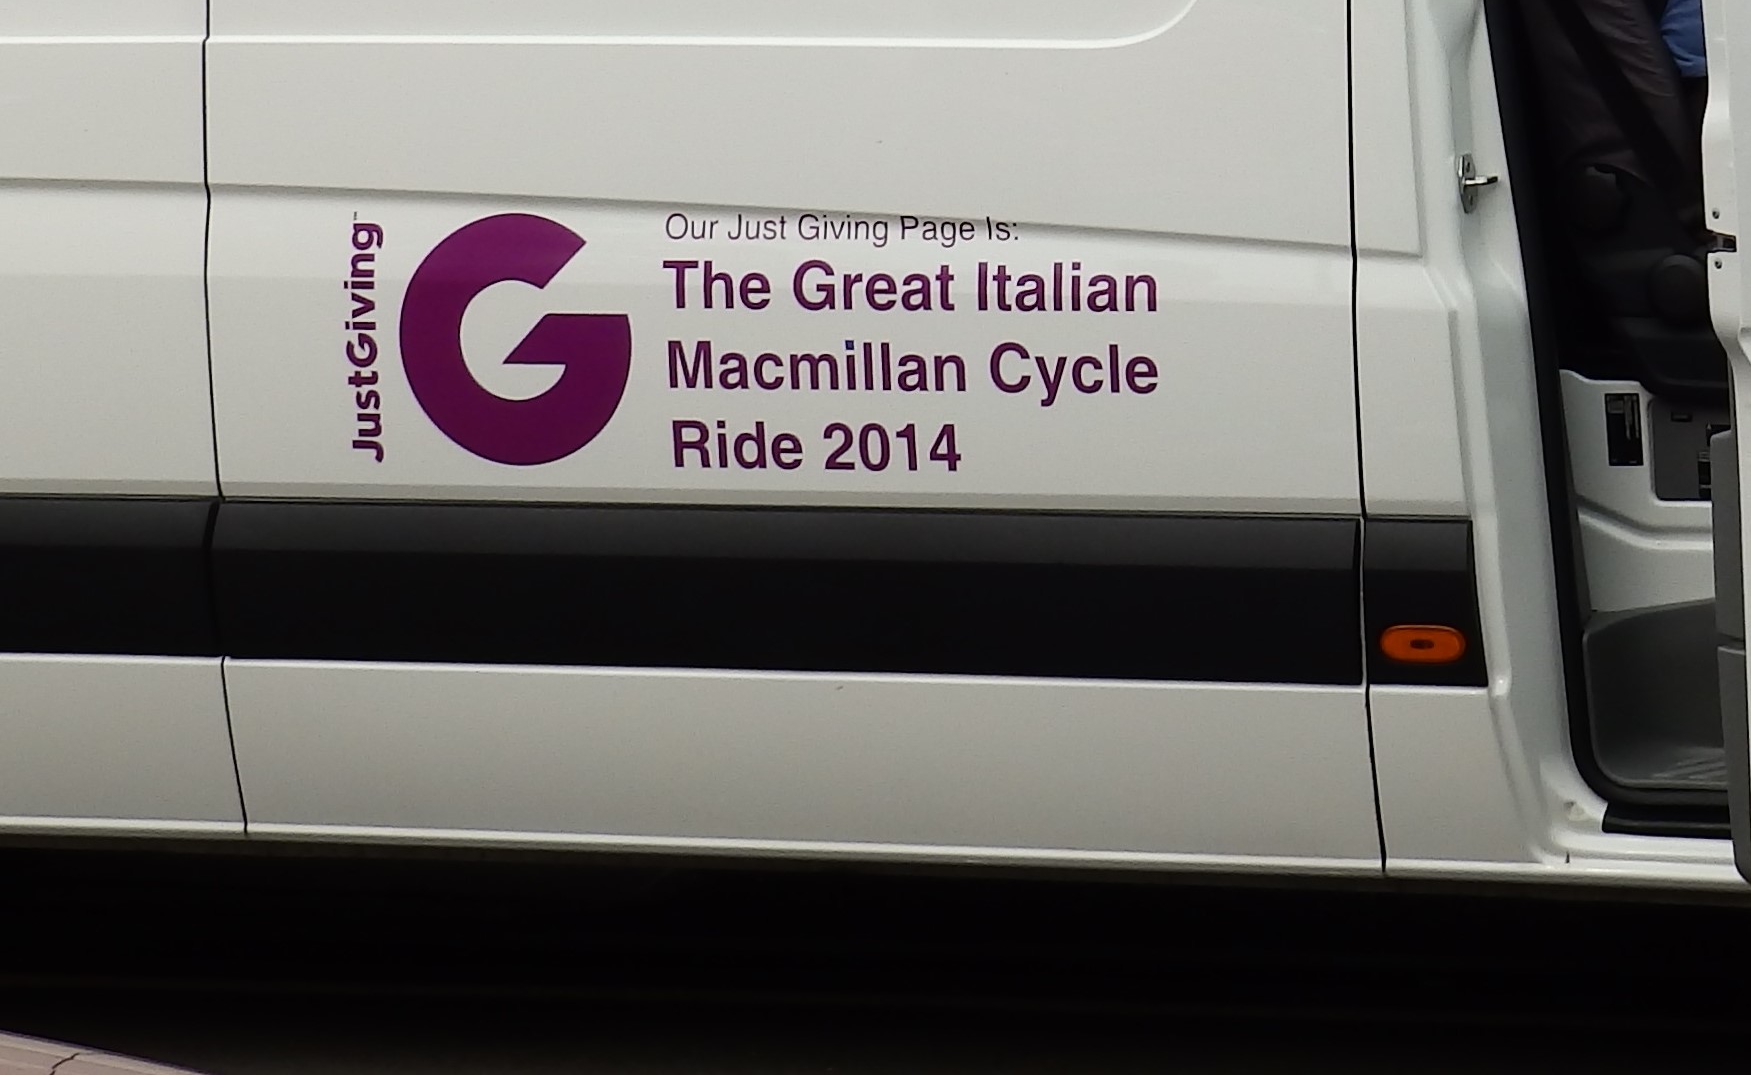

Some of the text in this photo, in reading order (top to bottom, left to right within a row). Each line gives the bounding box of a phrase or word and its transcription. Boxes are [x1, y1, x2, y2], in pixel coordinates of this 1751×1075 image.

[665, 212, 1019, 248] Our Just Giving Page Is:
[662, 259, 1159, 313] The Great Italian
[344, 221, 385, 463] JustGiving
[667, 339, 1160, 408] Macmillan Cycle
[672, 419, 962, 472] Ride 2014
